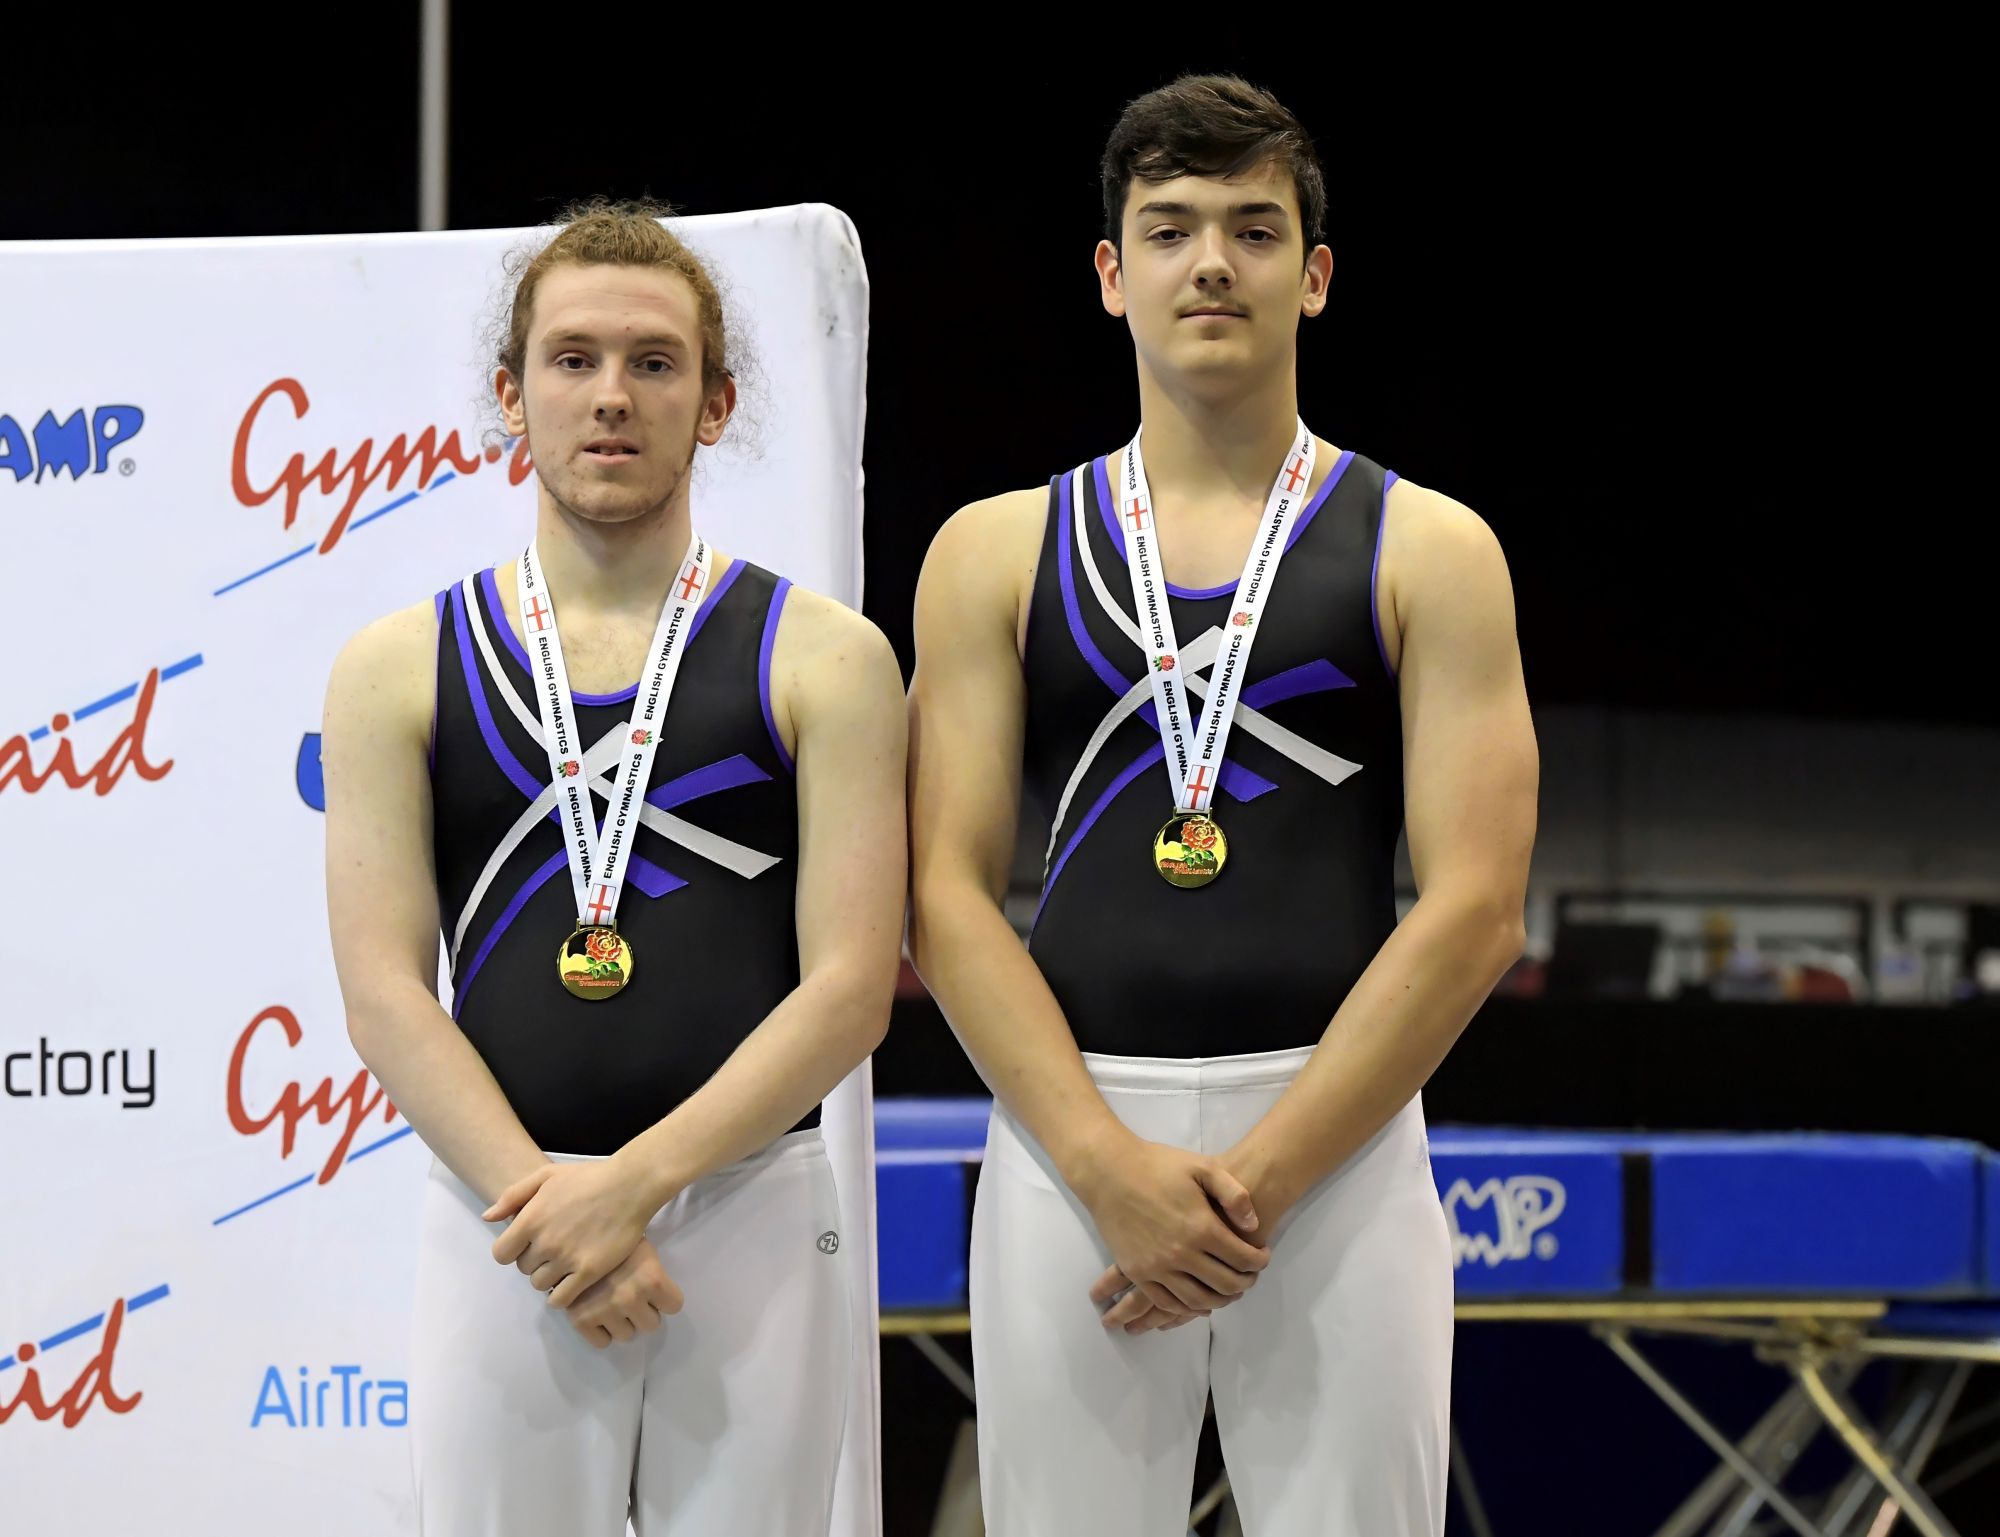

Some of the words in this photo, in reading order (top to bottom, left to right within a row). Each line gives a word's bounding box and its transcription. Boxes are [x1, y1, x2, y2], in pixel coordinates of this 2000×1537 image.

[1136, 536, 1151, 577] ENGLISH
[1245, 560, 1266, 604] ENGLISH
[1261, 499, 1289, 557] GYMNASTICS
[644, 672, 663, 720] ENGLISH
[657, 606, 685, 670] GYMNASTICS
[1143, 579, 1165, 649] GYMNASTICS
[538, 636, 555, 681] ENGLISH
[548, 684, 569, 755] GYMNASTICS
[1162, 680, 1181, 730] ENGLISH
[1174, 730, 1188, 782] GYMNA
[1202, 711, 1221, 760] ENGLISH
[1217, 634, 1243, 707] GYMNASTICS
[567, 786, 585, 836] ENGLISH
[603, 830, 622, 879] ENGLISH
[616, 753, 642, 827] GYMNASTICS
[5, 1037, 155, 1108] ctory
[250, 1365, 408, 1428] AirTra
